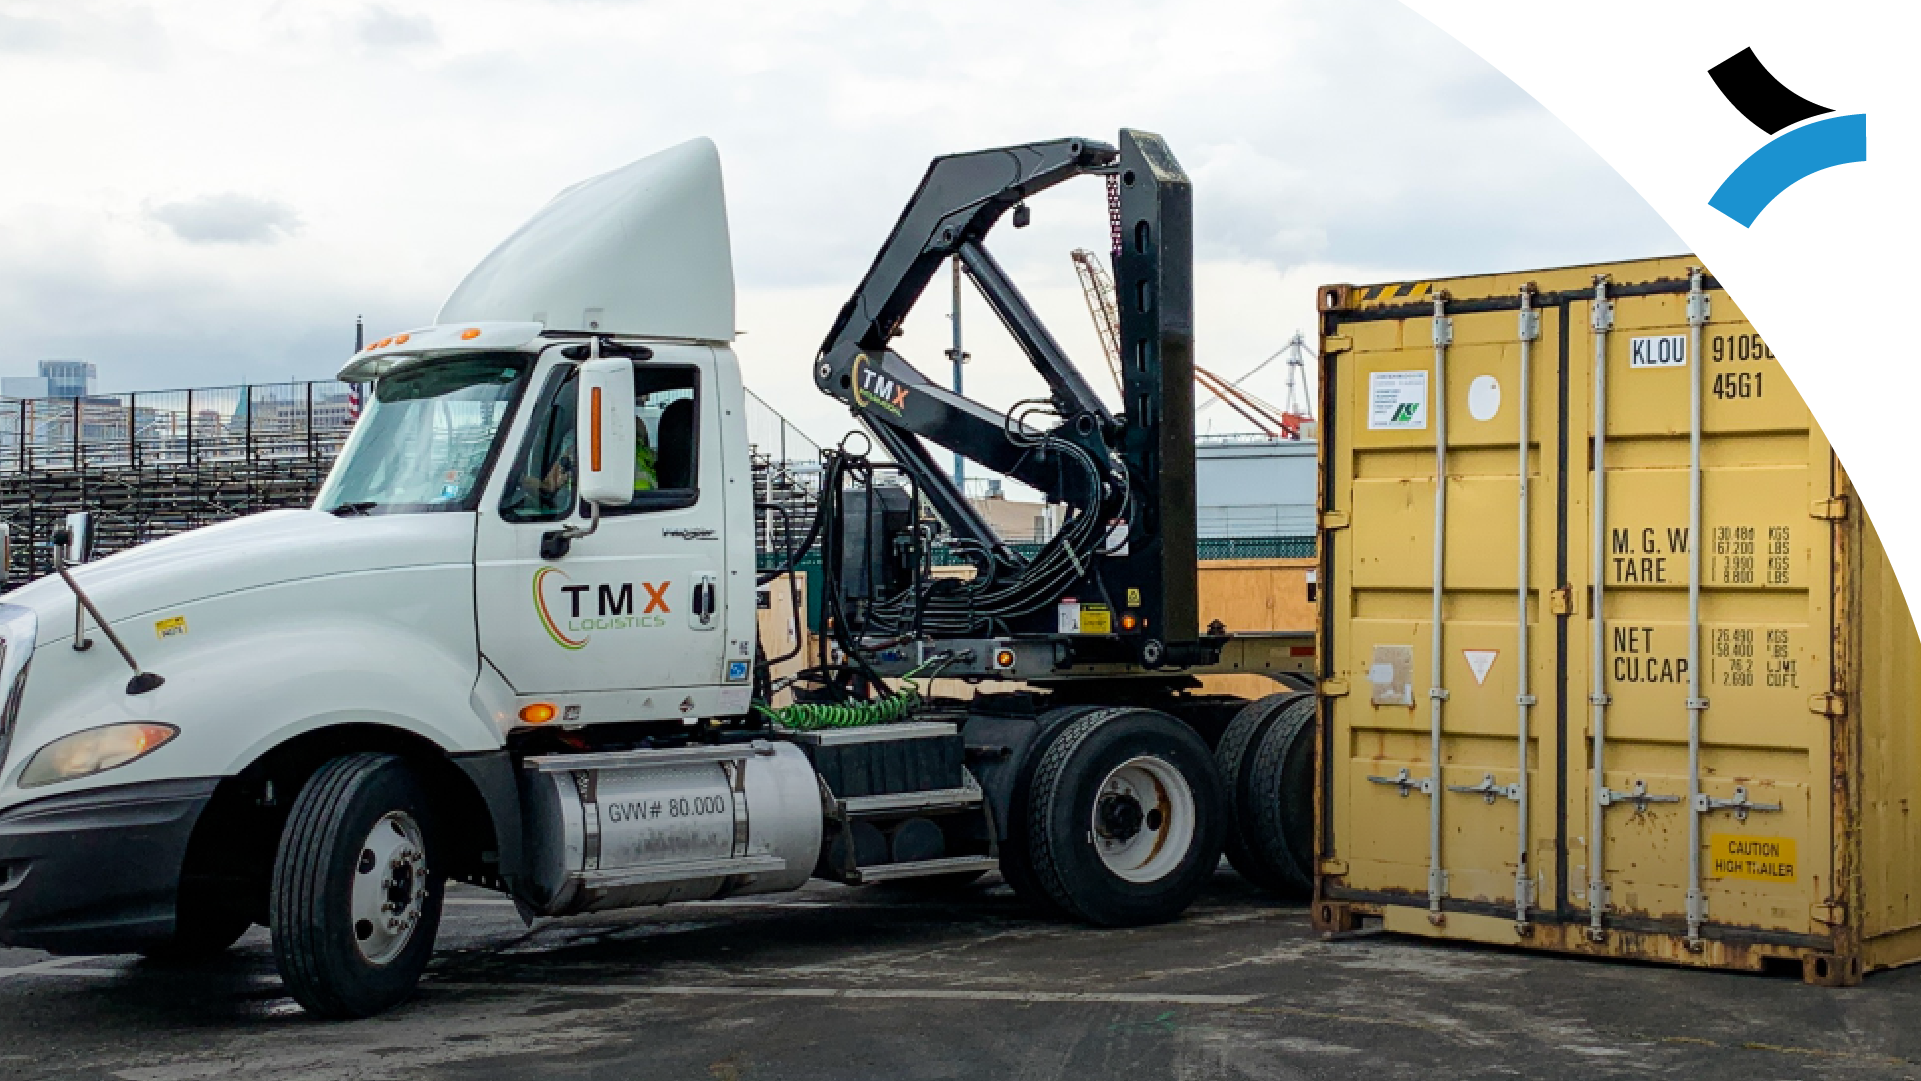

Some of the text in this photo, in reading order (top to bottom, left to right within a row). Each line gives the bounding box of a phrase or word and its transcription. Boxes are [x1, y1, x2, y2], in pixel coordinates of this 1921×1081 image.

[1633, 337, 1685, 365] KLOU
[863, 367, 910, 410] TMX
[1712, 371, 1763, 400] 45G1
[1768, 526, 1790, 541] KGS
[1717, 541, 1790, 555] 67.200 LBS
[1612, 555, 1790, 584] TARE 3.990 KGS
[1723, 570, 1790, 584] 8.800 LBS
[560, 580, 672, 618] TMX
[568, 614, 666, 632] LOGISTICS
[1614, 626, 1655, 654] NET
[1766, 628, 1789, 644] KGS
[669, 794, 725, 818] 80.000
[1728, 840, 1780, 857] CAUTION
[1715, 858, 1744, 874] HIGH
